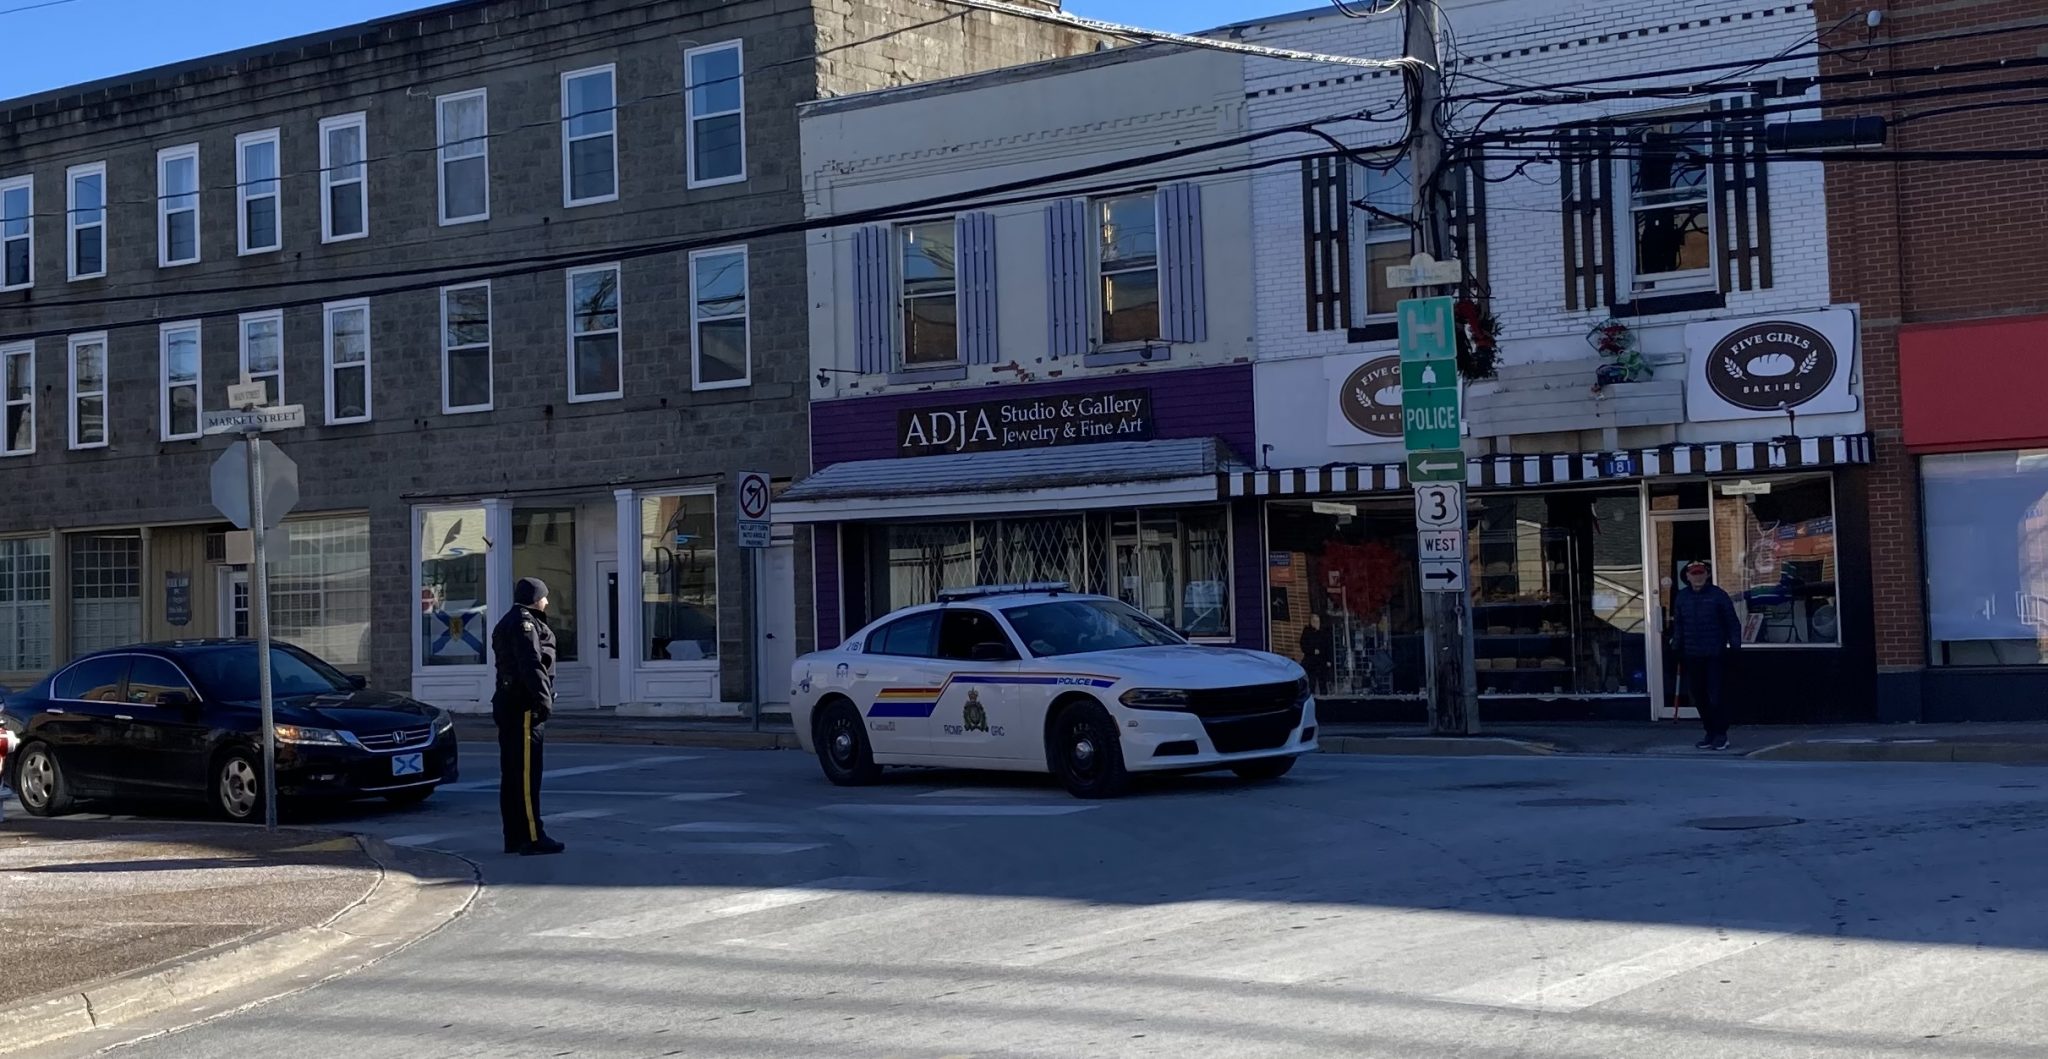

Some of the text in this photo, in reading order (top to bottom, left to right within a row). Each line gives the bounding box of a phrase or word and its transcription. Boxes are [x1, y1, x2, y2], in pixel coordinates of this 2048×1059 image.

[1407, 307, 1445, 349] H
[1731, 332, 1811, 355] FIVE GIRLS
[1361, 366, 1388, 386] FIVE
[1743, 382, 1801, 394] BAKING
[1001, 394, 1142, 423] Studio & Gallery
[1406, 406, 1456, 430] POLICE
[208, 412, 297, 427] MARKET STREET
[902, 408, 997, 452] ADJA
[1001, 417, 1143, 446] Jewelry & Fine Art
[1609, 460, 1632, 473] 181
[1430, 490, 1447, 520] 3
[1425, 538, 1456, 551] WEST
[1058, 677, 1092, 686] POLICE
[943, 724, 962, 736] RCMP
[991, 725, 1005, 737] GRC
